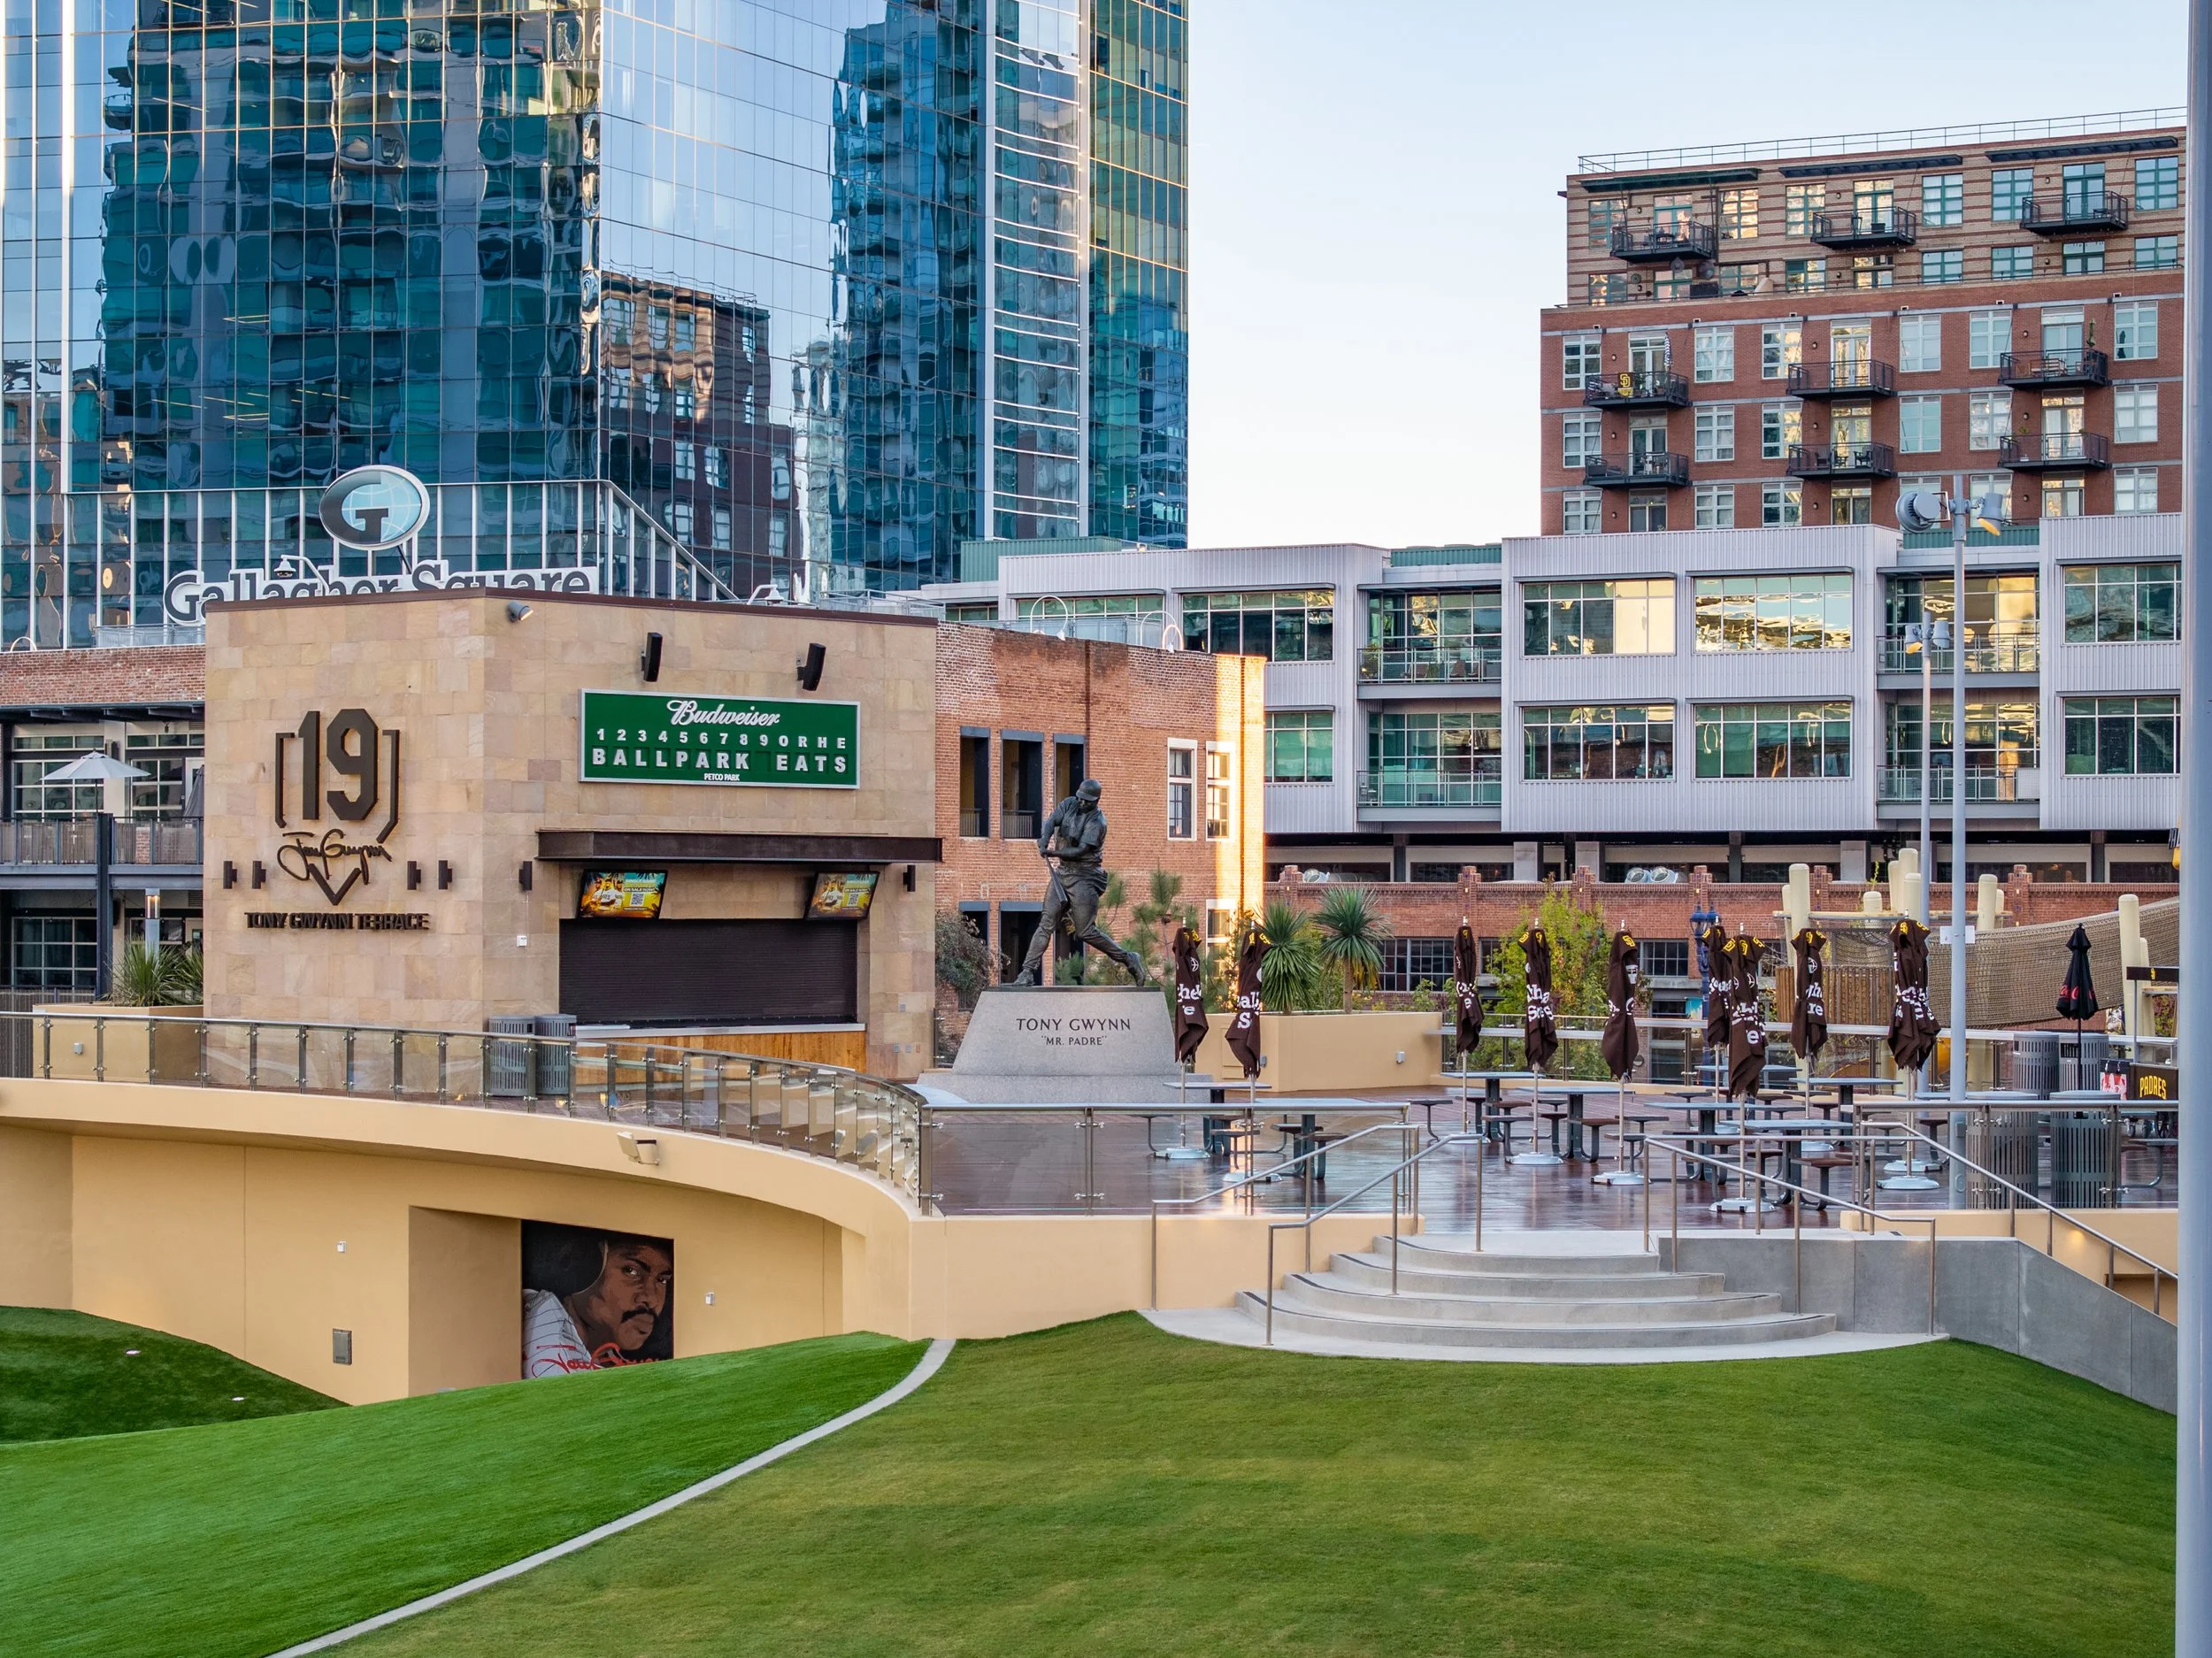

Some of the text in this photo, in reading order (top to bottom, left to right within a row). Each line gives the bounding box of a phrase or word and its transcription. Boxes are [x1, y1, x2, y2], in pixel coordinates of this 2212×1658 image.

[666, 700, 780, 726] Budweiser
[298, 708, 379, 820] 19
[592, 748, 846, 773] BALLPARK EATS
[703, 772, 724, 781] PETCO
[244, 912, 429, 930] TONY GWYNN TERRACE
[1016, 1018, 1131, 1031] TONY GWYNN
[2139, 1075, 2167, 1100] PADRES
